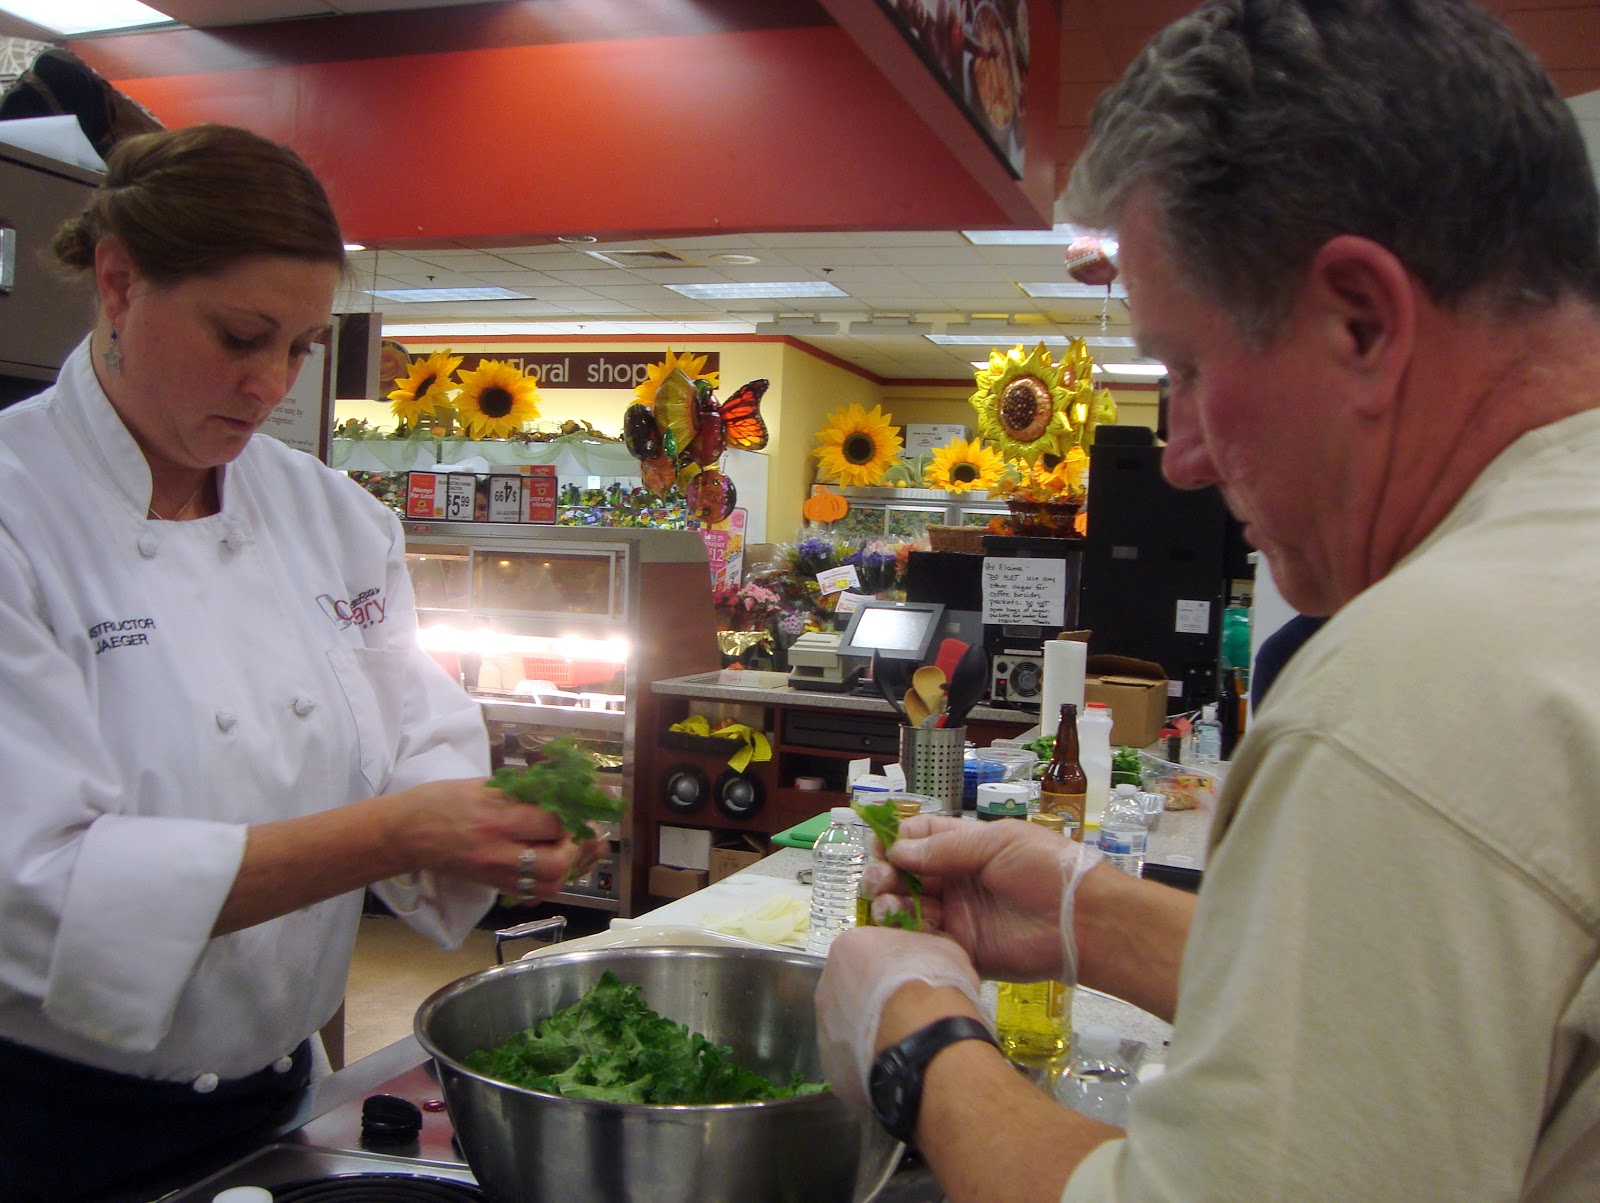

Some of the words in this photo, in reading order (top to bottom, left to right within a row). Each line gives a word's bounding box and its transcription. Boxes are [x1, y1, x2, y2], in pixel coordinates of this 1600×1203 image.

[508, 358, 569, 383] loral
[586, 358, 650, 388] shop
[95, 634, 149, 655] JAEGER
